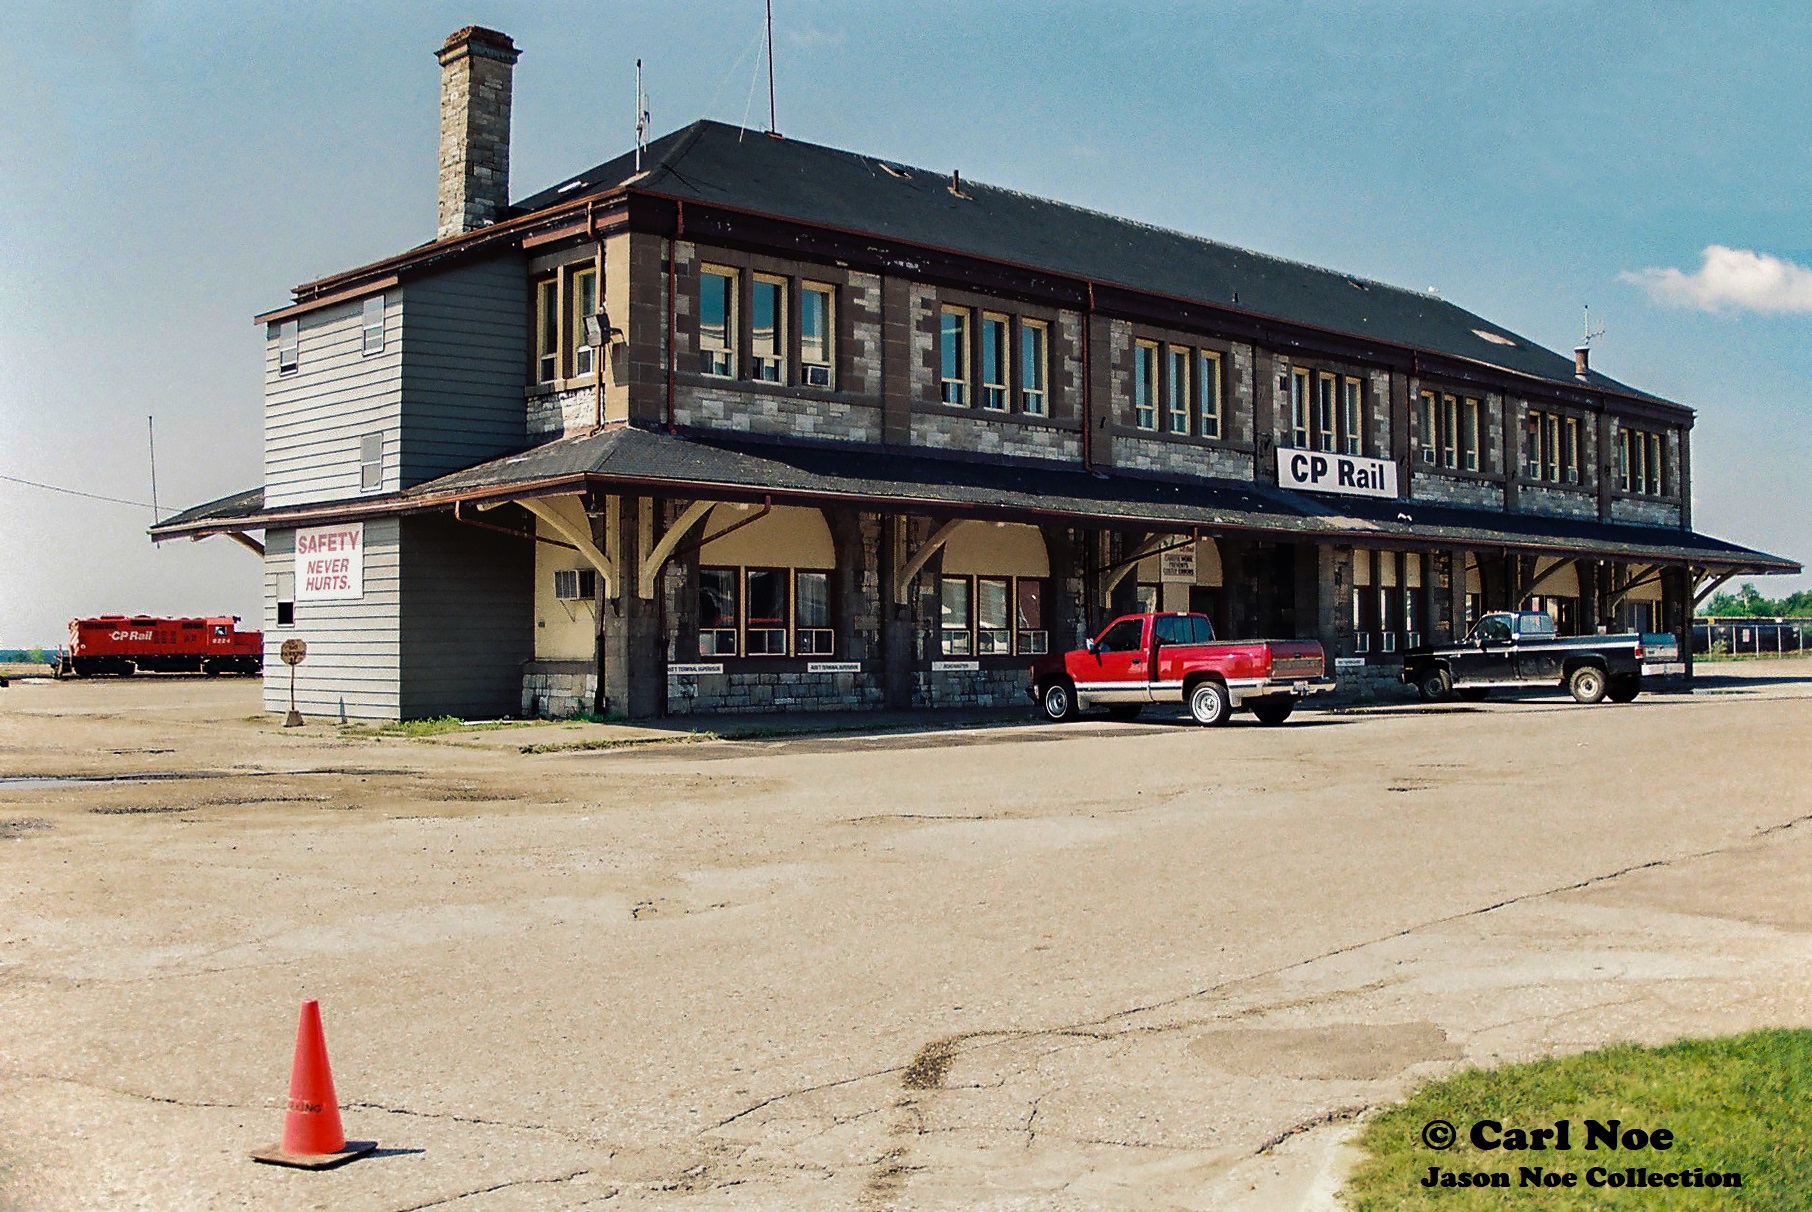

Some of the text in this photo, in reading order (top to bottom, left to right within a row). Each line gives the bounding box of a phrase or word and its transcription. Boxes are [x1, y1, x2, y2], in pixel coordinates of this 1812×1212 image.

[1290, 453, 1386, 491] CP Rail
[298, 530, 361, 555] SAFETY
[306, 558, 350, 575] NEVER
[305, 575, 351, 592] HURTS.
[111, 630, 153, 641] CP Rail
